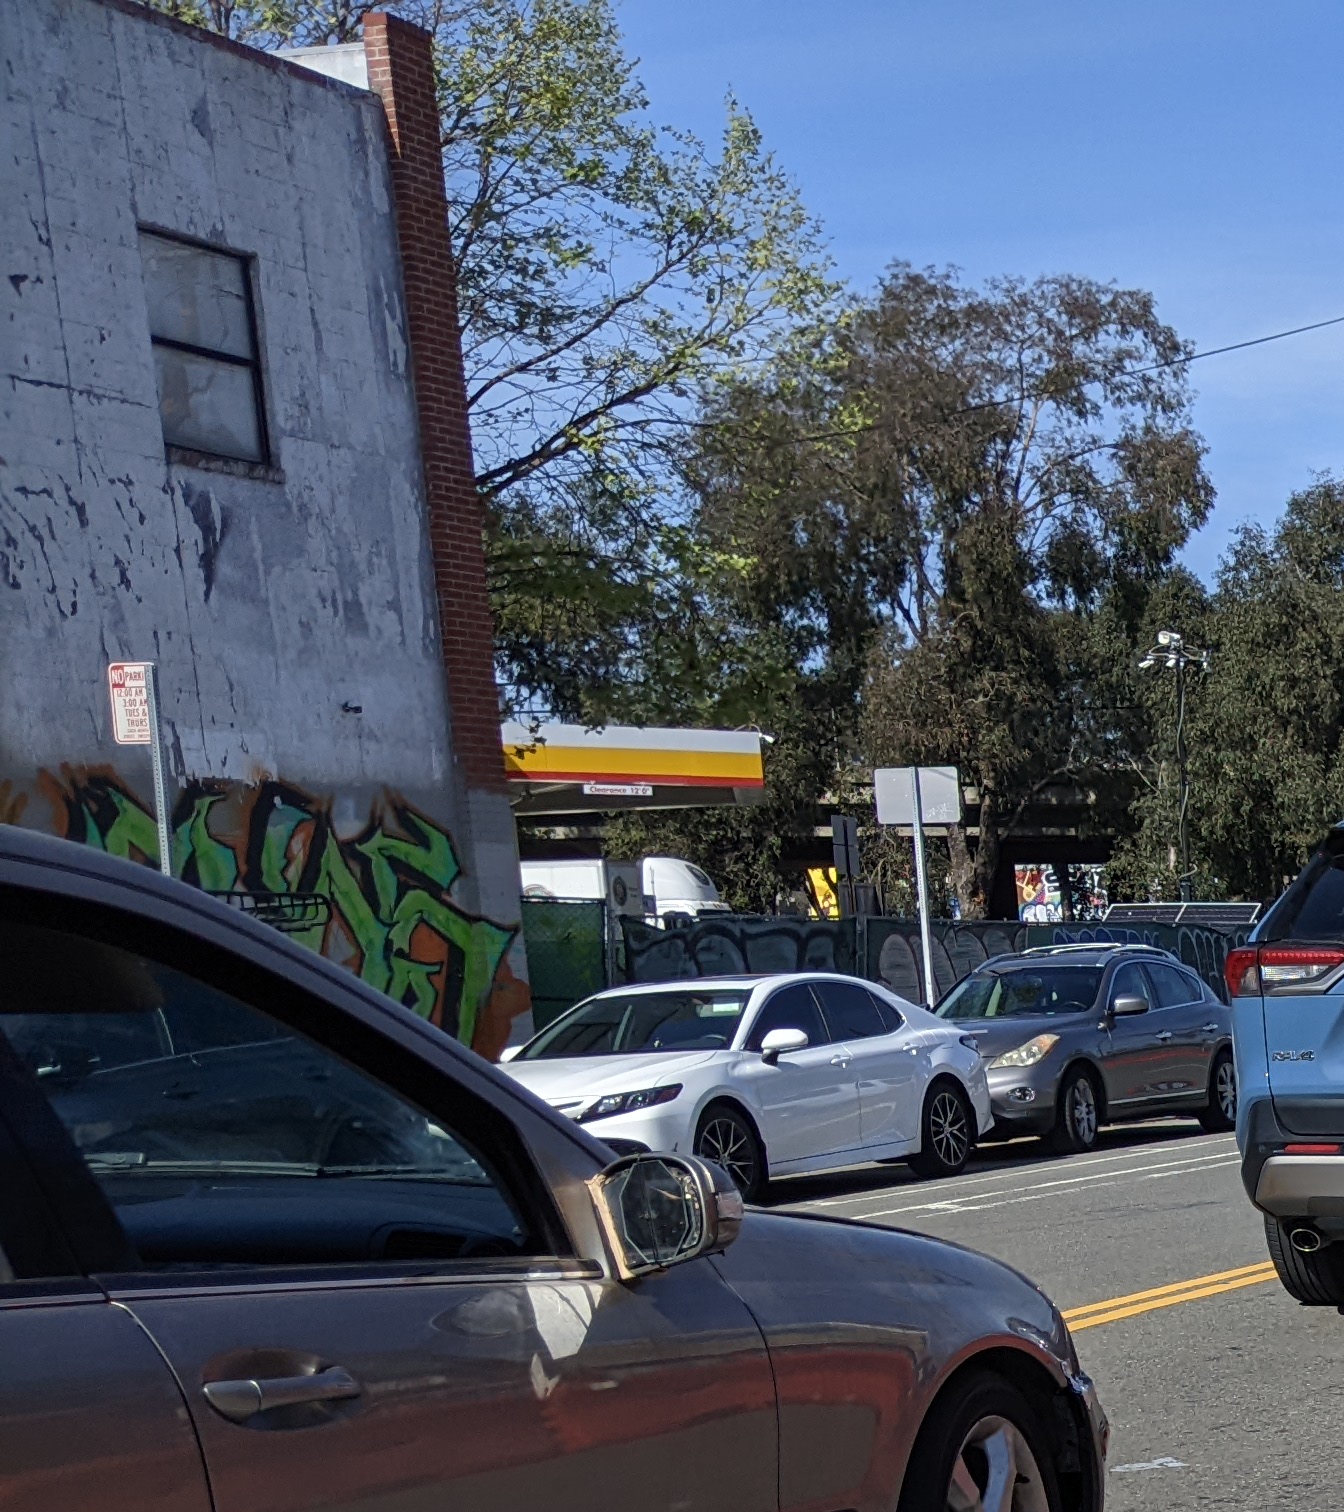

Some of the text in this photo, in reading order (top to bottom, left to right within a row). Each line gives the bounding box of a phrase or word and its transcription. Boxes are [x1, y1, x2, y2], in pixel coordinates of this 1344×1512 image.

[111, 669, 144, 685] NO PARKI
[134, 689, 144, 697] AM
[125, 708, 140, 718] TUES
[127, 719, 148, 728] THURS
[1272, 1050, 1315, 1061] RAV4
